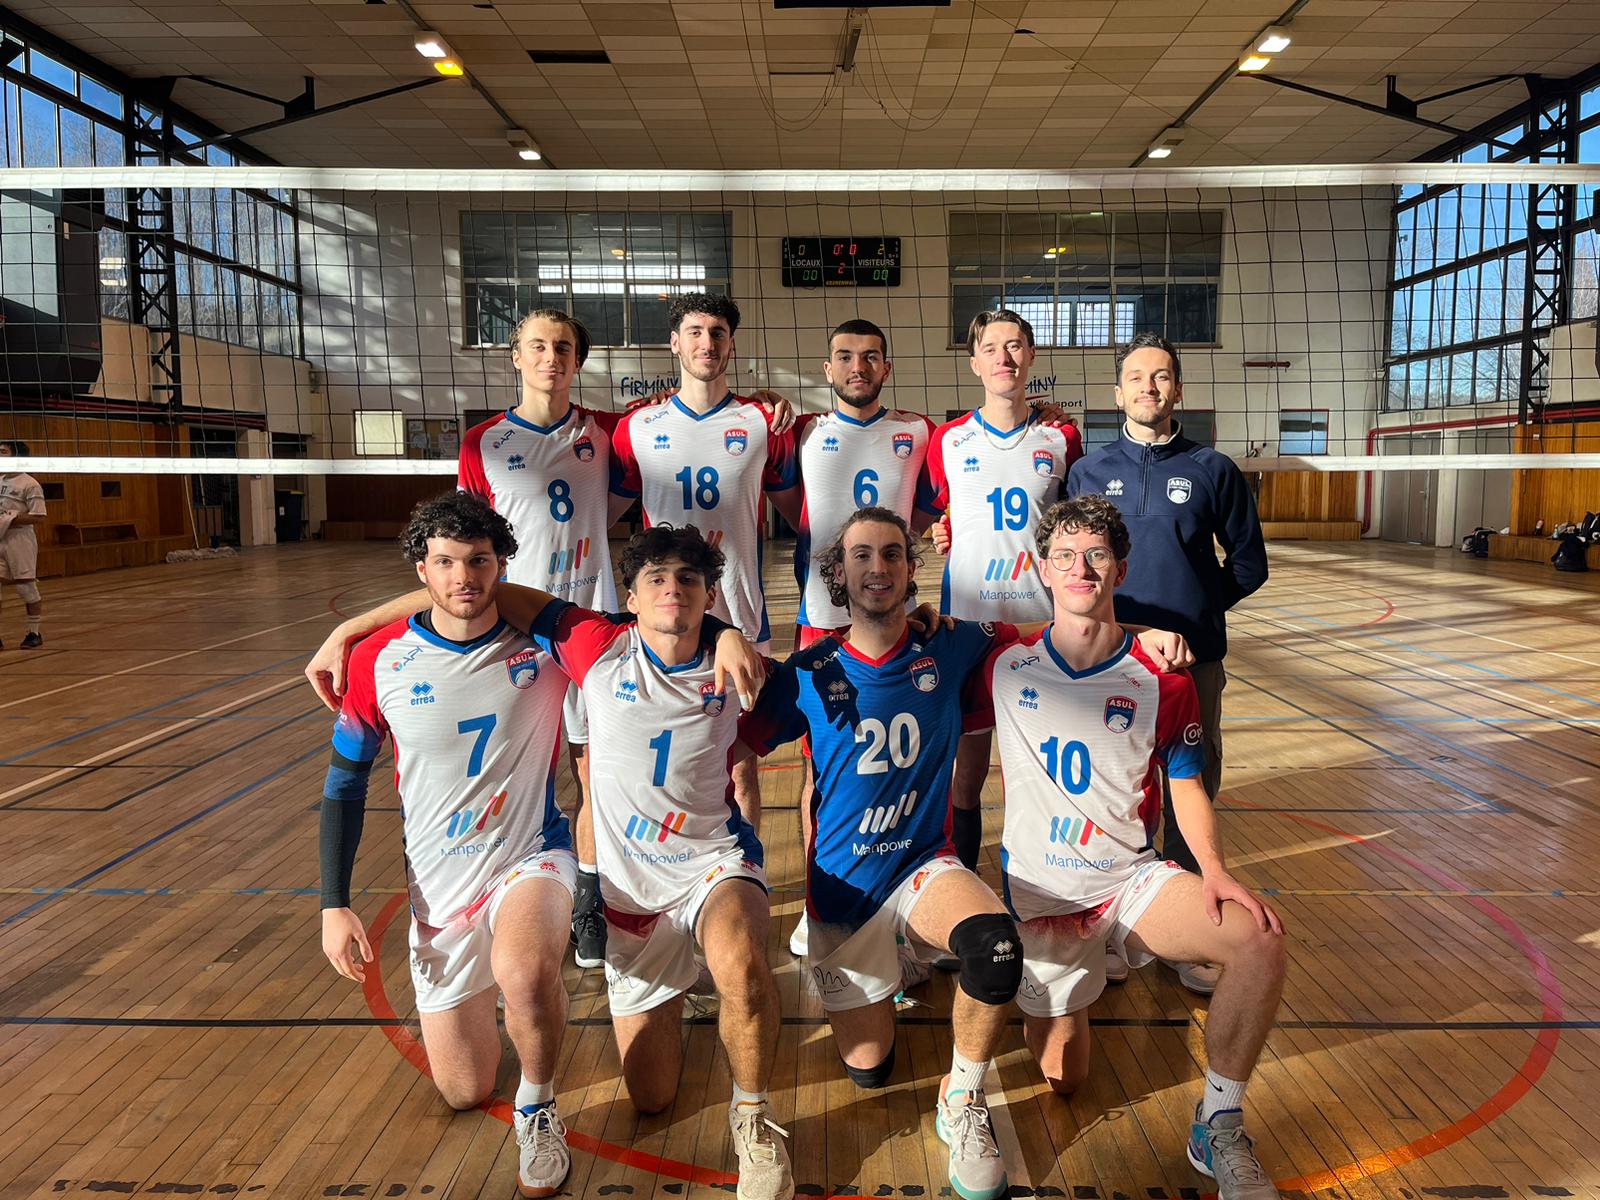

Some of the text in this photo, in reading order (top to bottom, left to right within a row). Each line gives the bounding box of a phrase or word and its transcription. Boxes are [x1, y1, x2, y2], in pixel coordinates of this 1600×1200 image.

[792, 259, 821, 267] LOCAUX
[858, 258, 895, 266] VISITEURS
[548, 479, 574, 522] 8
[676, 466, 720, 510] 18
[854, 468, 879, 510] 6
[986, 487, 1028, 531] 19
[546, 575, 601, 593] Manpower
[980, 590, 1036, 602] Manpower
[510, 653, 534, 666] ASUL
[912, 659, 933, 671] ASUL
[1109, 699, 1133, 710] ASUL
[458, 713, 497, 778] 7
[649, 729, 672, 787] 1
[854, 712, 920, 775] 20
[1040, 736, 1092, 796] 10
[1045, 852, 1116, 870] Manpower
